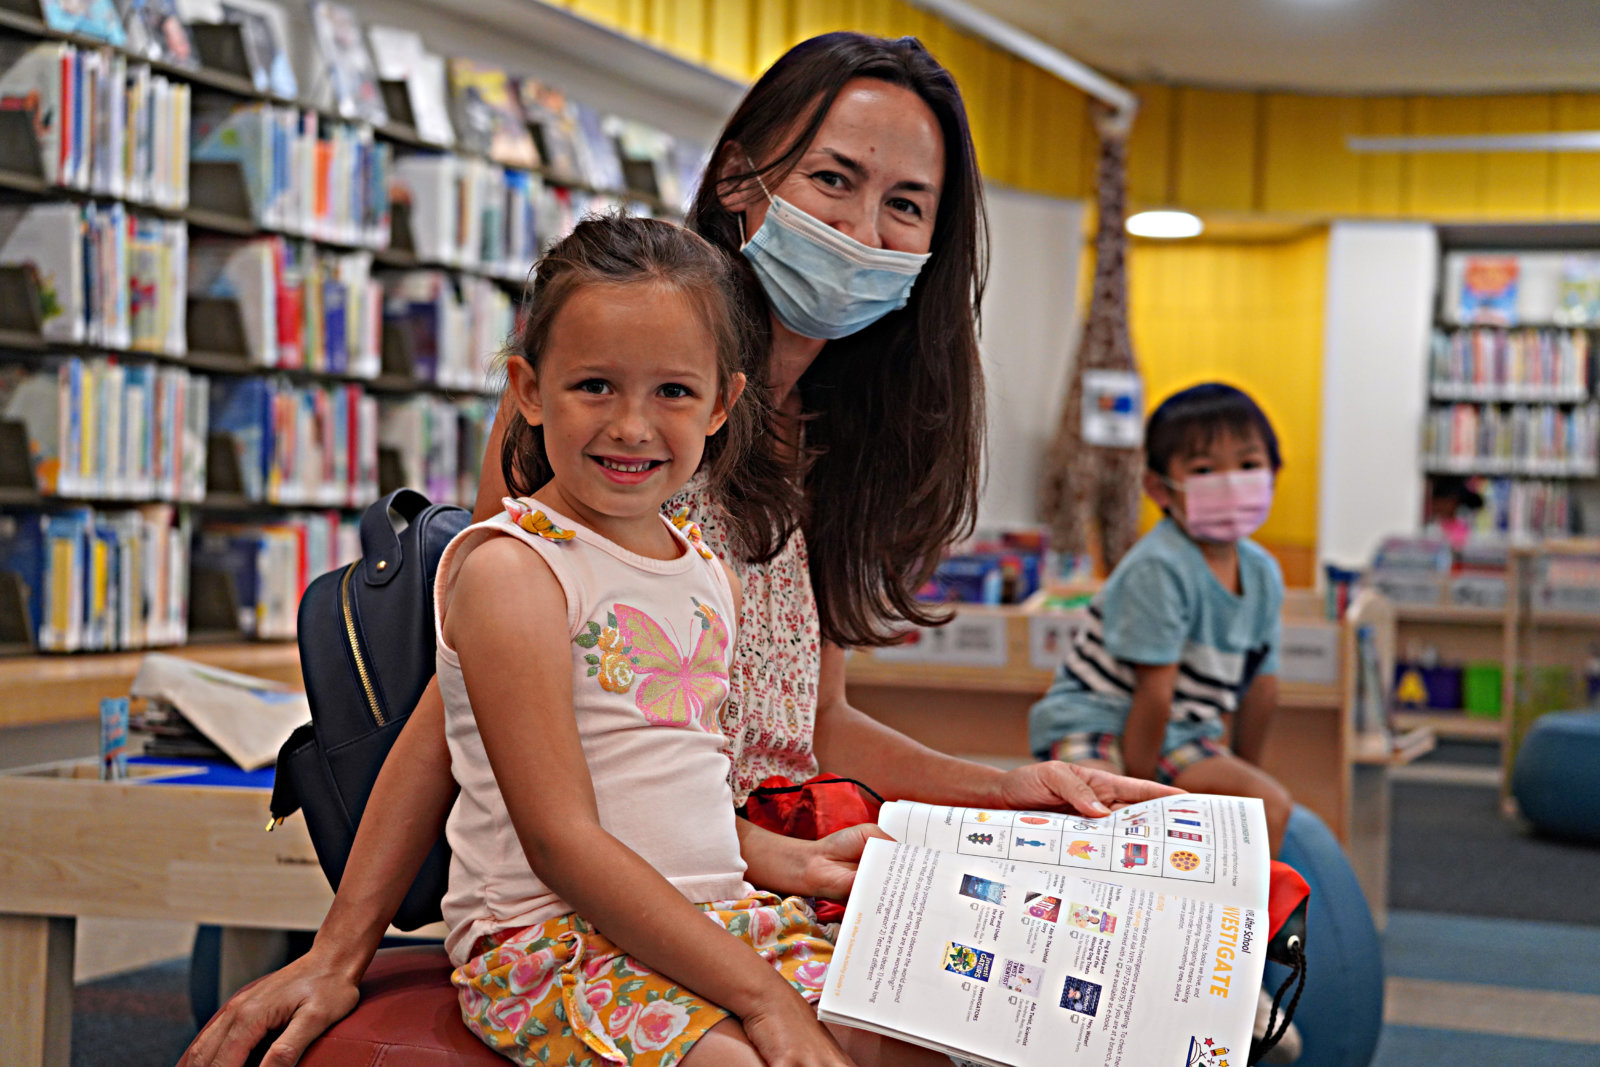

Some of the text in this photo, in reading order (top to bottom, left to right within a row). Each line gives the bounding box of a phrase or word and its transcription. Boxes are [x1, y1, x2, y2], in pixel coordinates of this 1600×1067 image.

[889, 922, 897, 934] Here
[913, 917, 922, 929] them
[1040, 922, 1048, 932] Story
[1244, 917, 1254, 929] After
[876, 936, 884, 946] Test
[1121, 929, 1129, 945] marked
[1241, 930, 1253, 953] School
[905, 937, 916, 957] observe
[1118, 946, 1126, 956] with
[1209, 905, 1241, 998] NVESTIGATE
[878, 956, 888, 970] ideas:
[1127, 951, 1135, 963] NYPL
[1178, 945, 1189, 969] something
[1199, 952, 1207, 965] books
[866, 958, 878, 980] different
[1001, 960, 1013, 985] SCIENTIST
[1131, 949, 1144, 982] investigations
[898, 968, 908, 982] world
[873, 978, 881, 989] How
[1108, 979, 1119, 1001] available
[1174, 983, 1182, 997] solve
[868, 991, 878, 1002] long
[893, 984, 904, 1002] around
[1181, 984, 1191, 1002] looking
[1026, 1012, 1034, 1025] Twist,
[1113, 1008, 1121, 1018] you
[1120, 994, 1134, 1029] investigating.
[1021, 1026, 1031, 1045] Scientist
[1116, 1039, 1125, 1054] check
